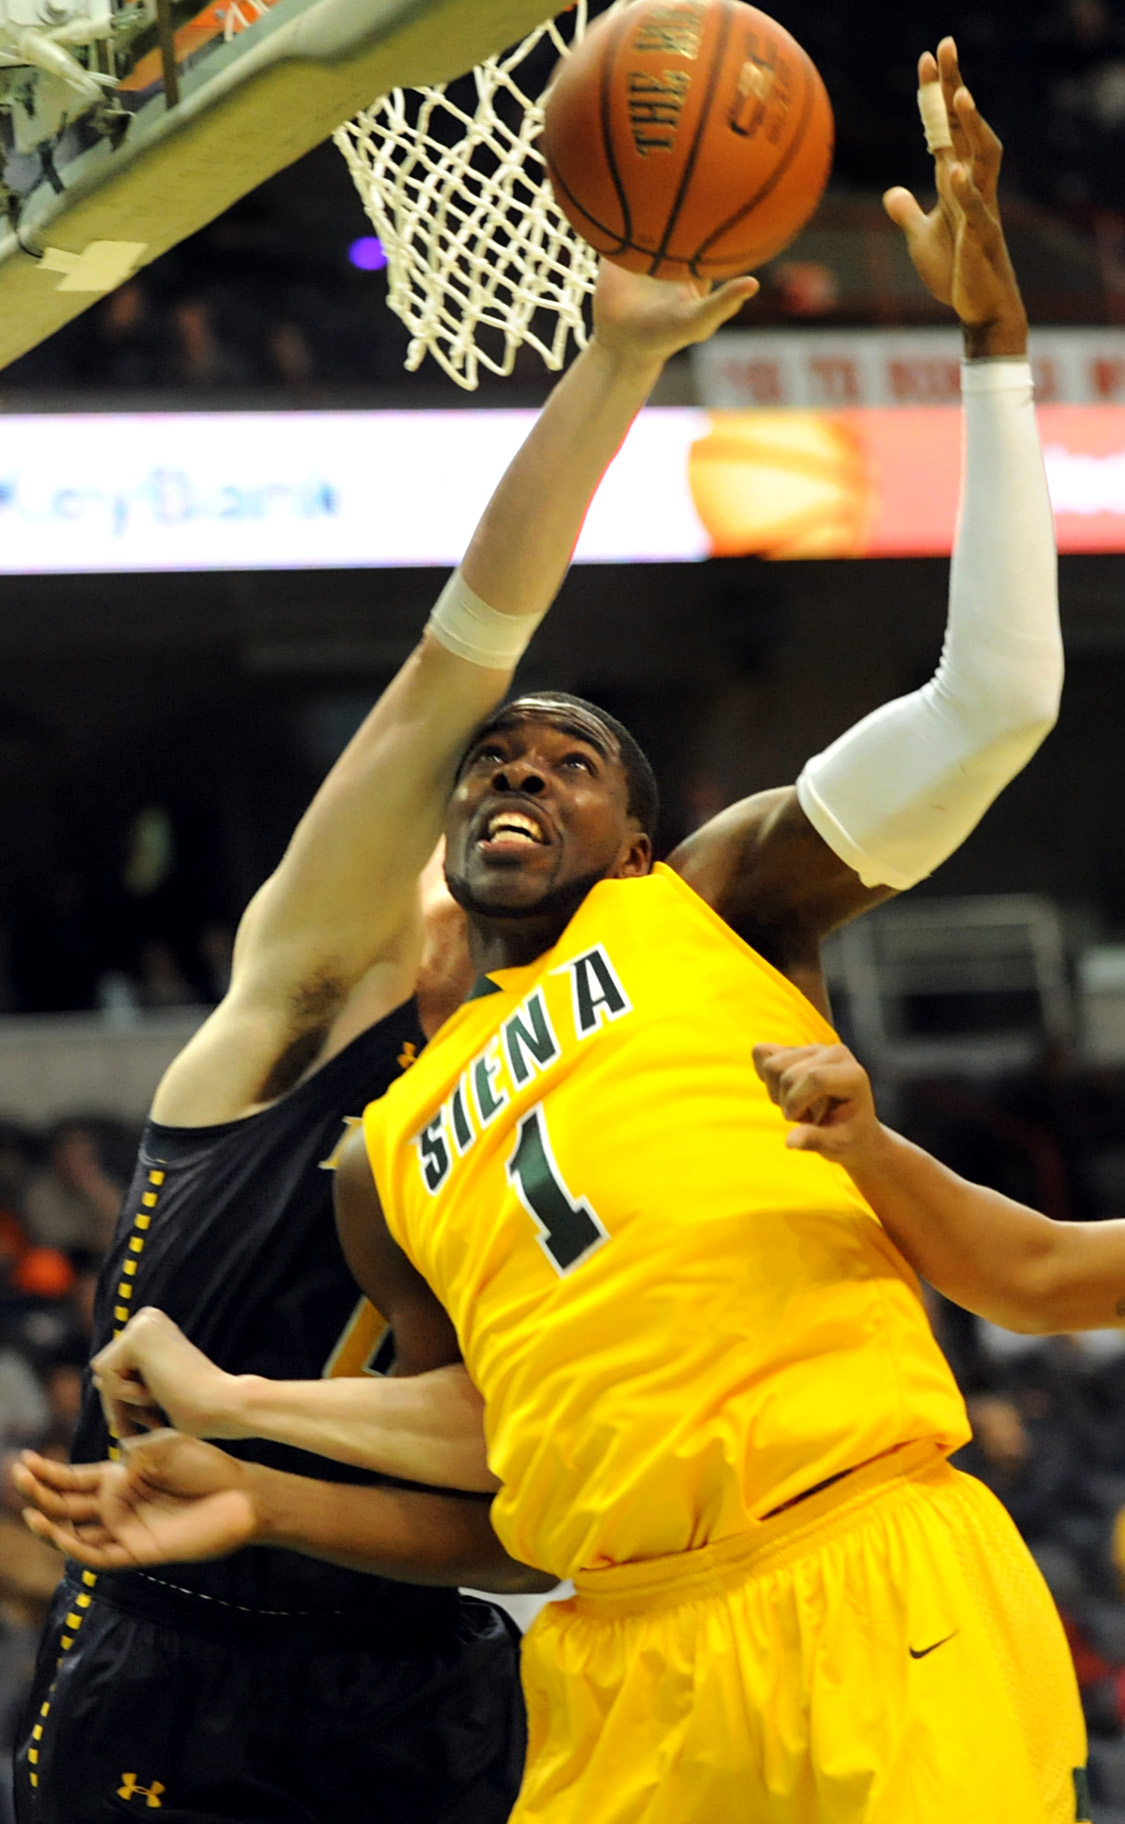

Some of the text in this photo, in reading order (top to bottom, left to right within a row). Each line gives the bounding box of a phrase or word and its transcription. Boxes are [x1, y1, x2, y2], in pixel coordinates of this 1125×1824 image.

[627, 68, 692, 158] THE
[412, 943, 633, 1195] SIENA
[506, 1102, 611, 1278] 1
